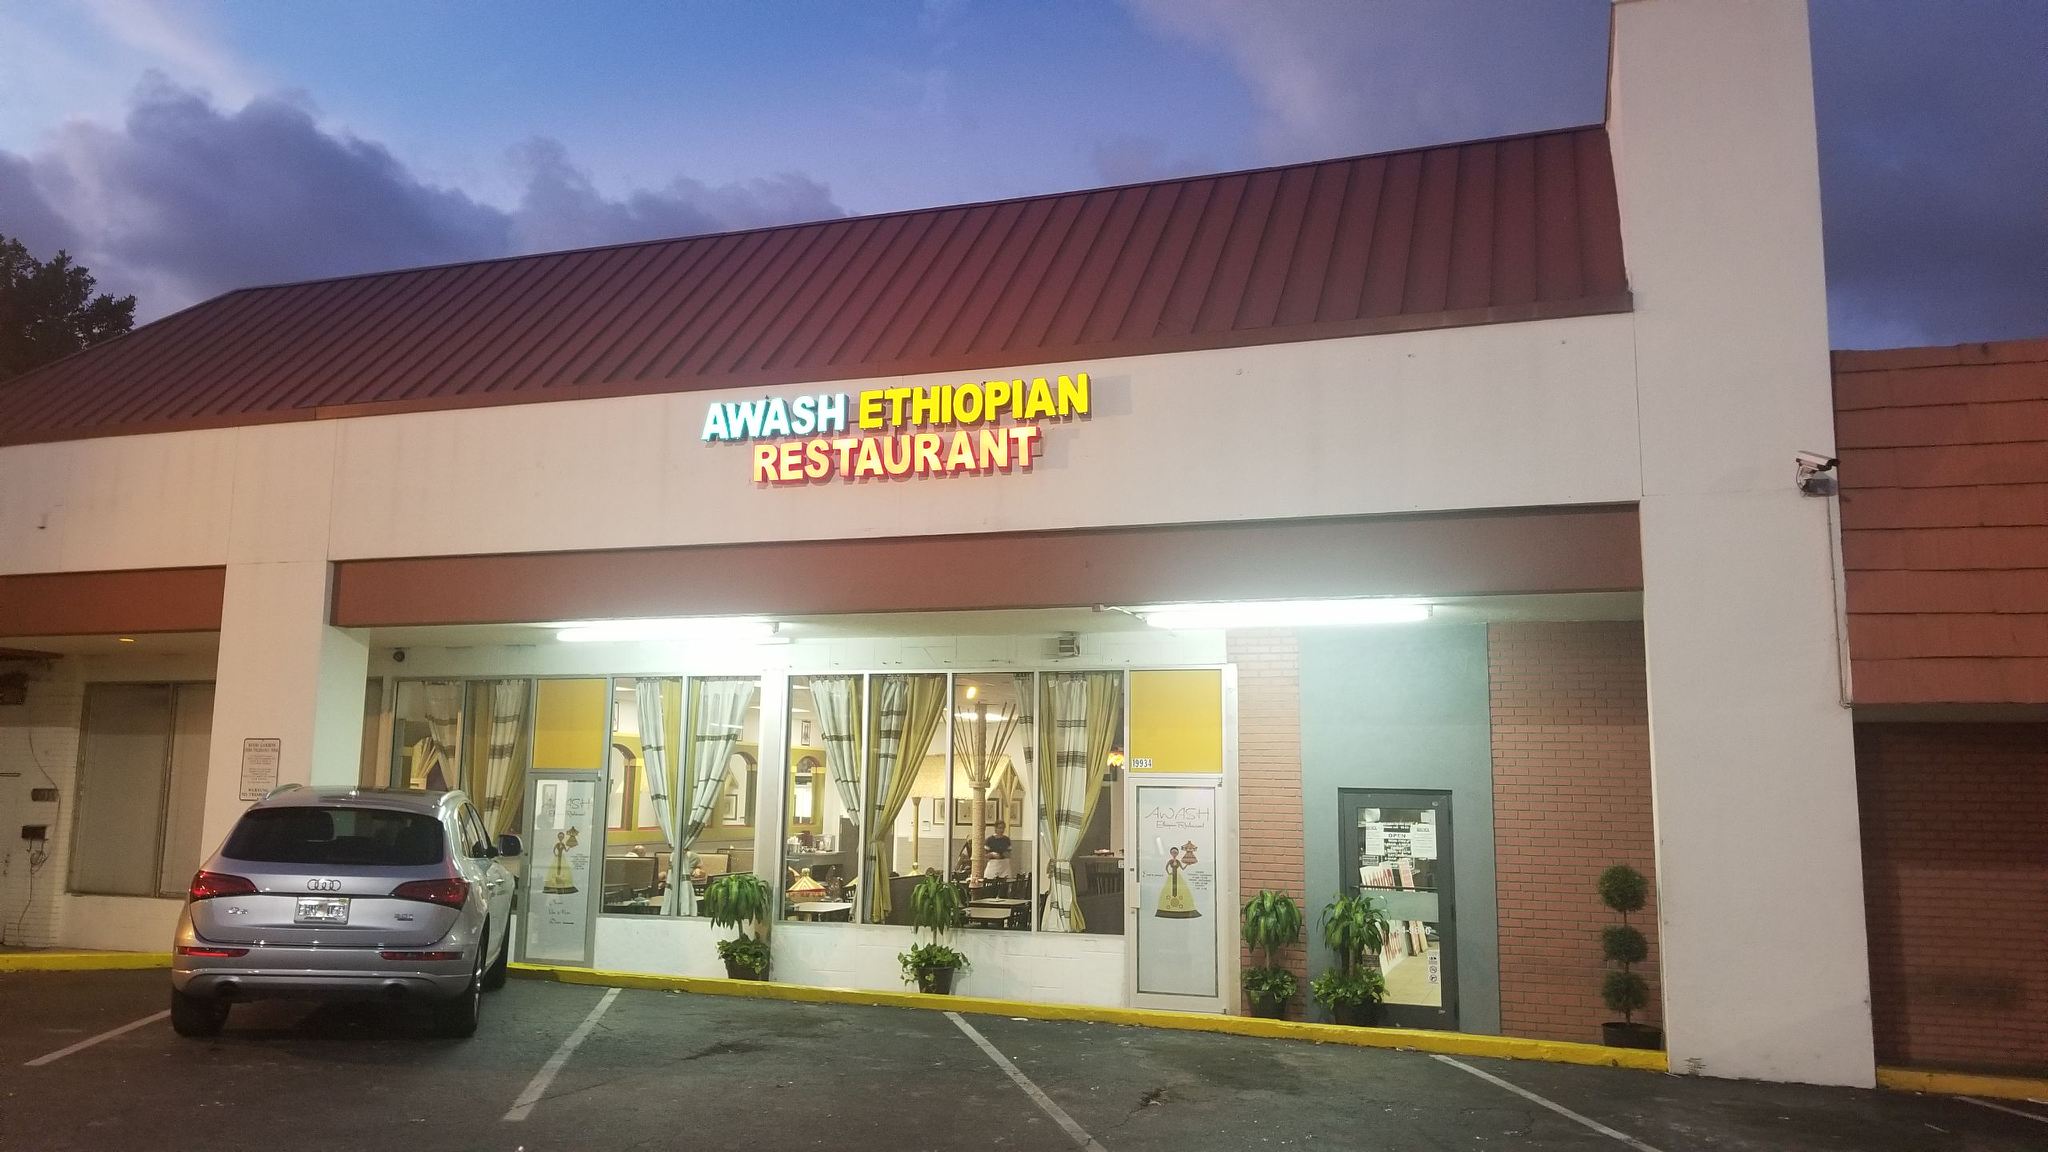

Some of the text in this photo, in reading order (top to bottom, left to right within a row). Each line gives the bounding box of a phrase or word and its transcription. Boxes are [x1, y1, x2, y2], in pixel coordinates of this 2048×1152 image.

[701, 372, 1090, 441] AWASH ETHIOPIAN
[753, 426, 1039, 483] RESTAURANT
[1132, 759, 1152, 768] 19934
[1145, 806, 1210, 822] AWASH
